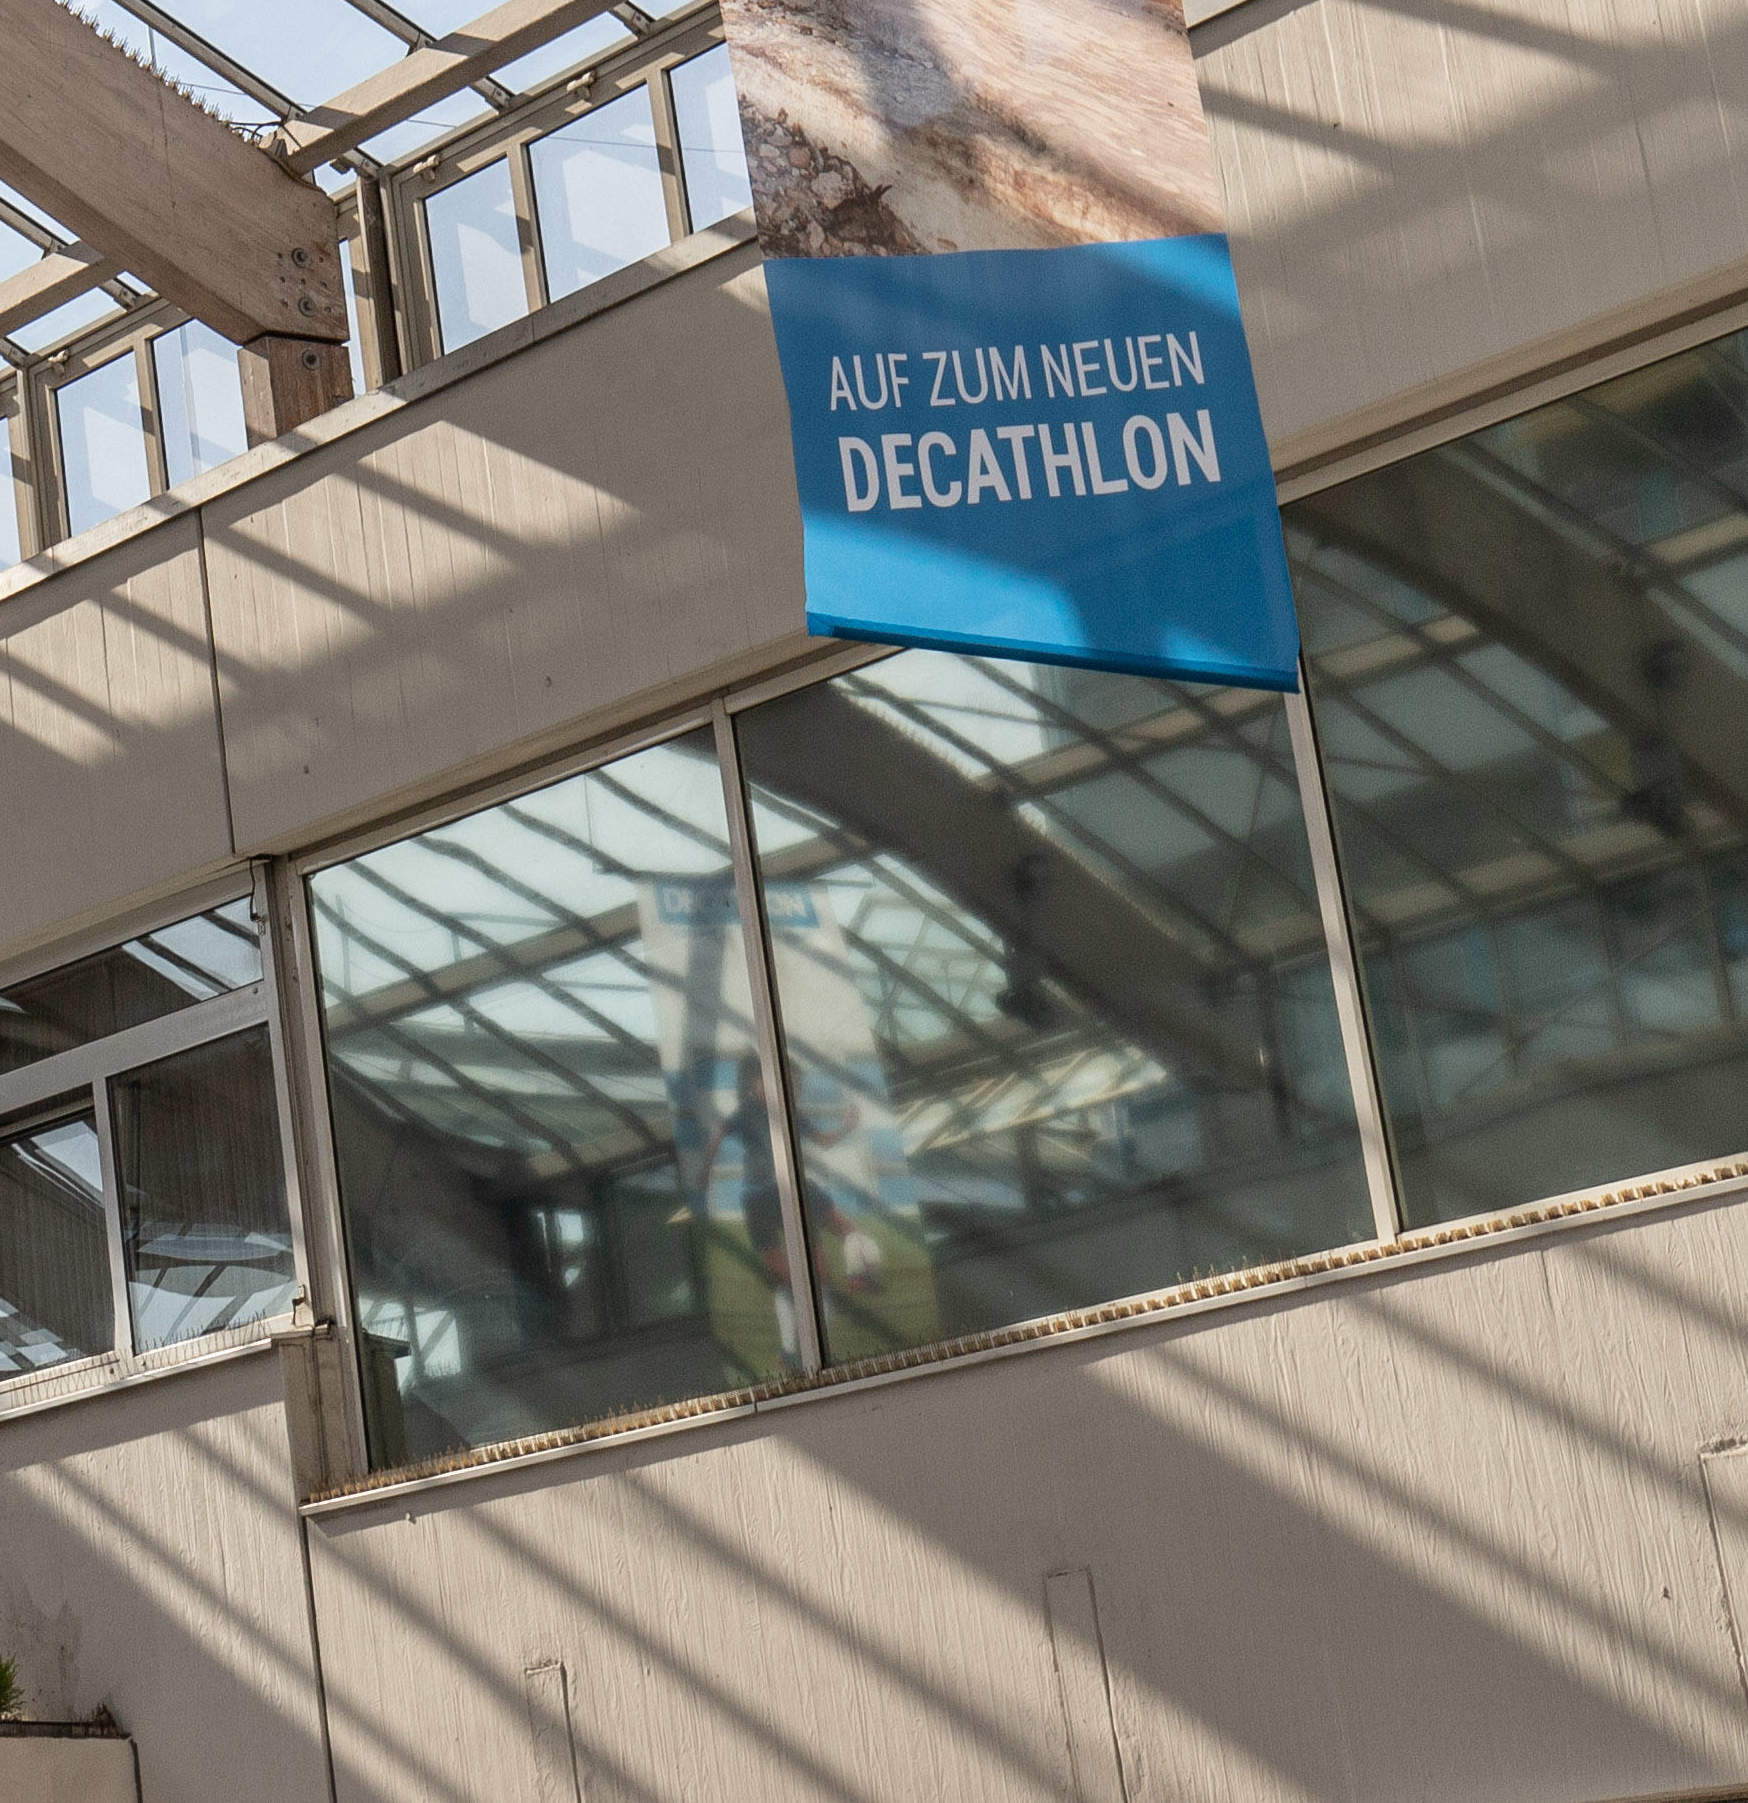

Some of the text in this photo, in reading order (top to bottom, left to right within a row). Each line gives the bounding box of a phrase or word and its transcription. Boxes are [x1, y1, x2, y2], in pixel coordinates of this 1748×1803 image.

[830, 331, 1205, 411] AUF ZUM NEUEN
[838, 408, 1221, 513] DECATHLON
